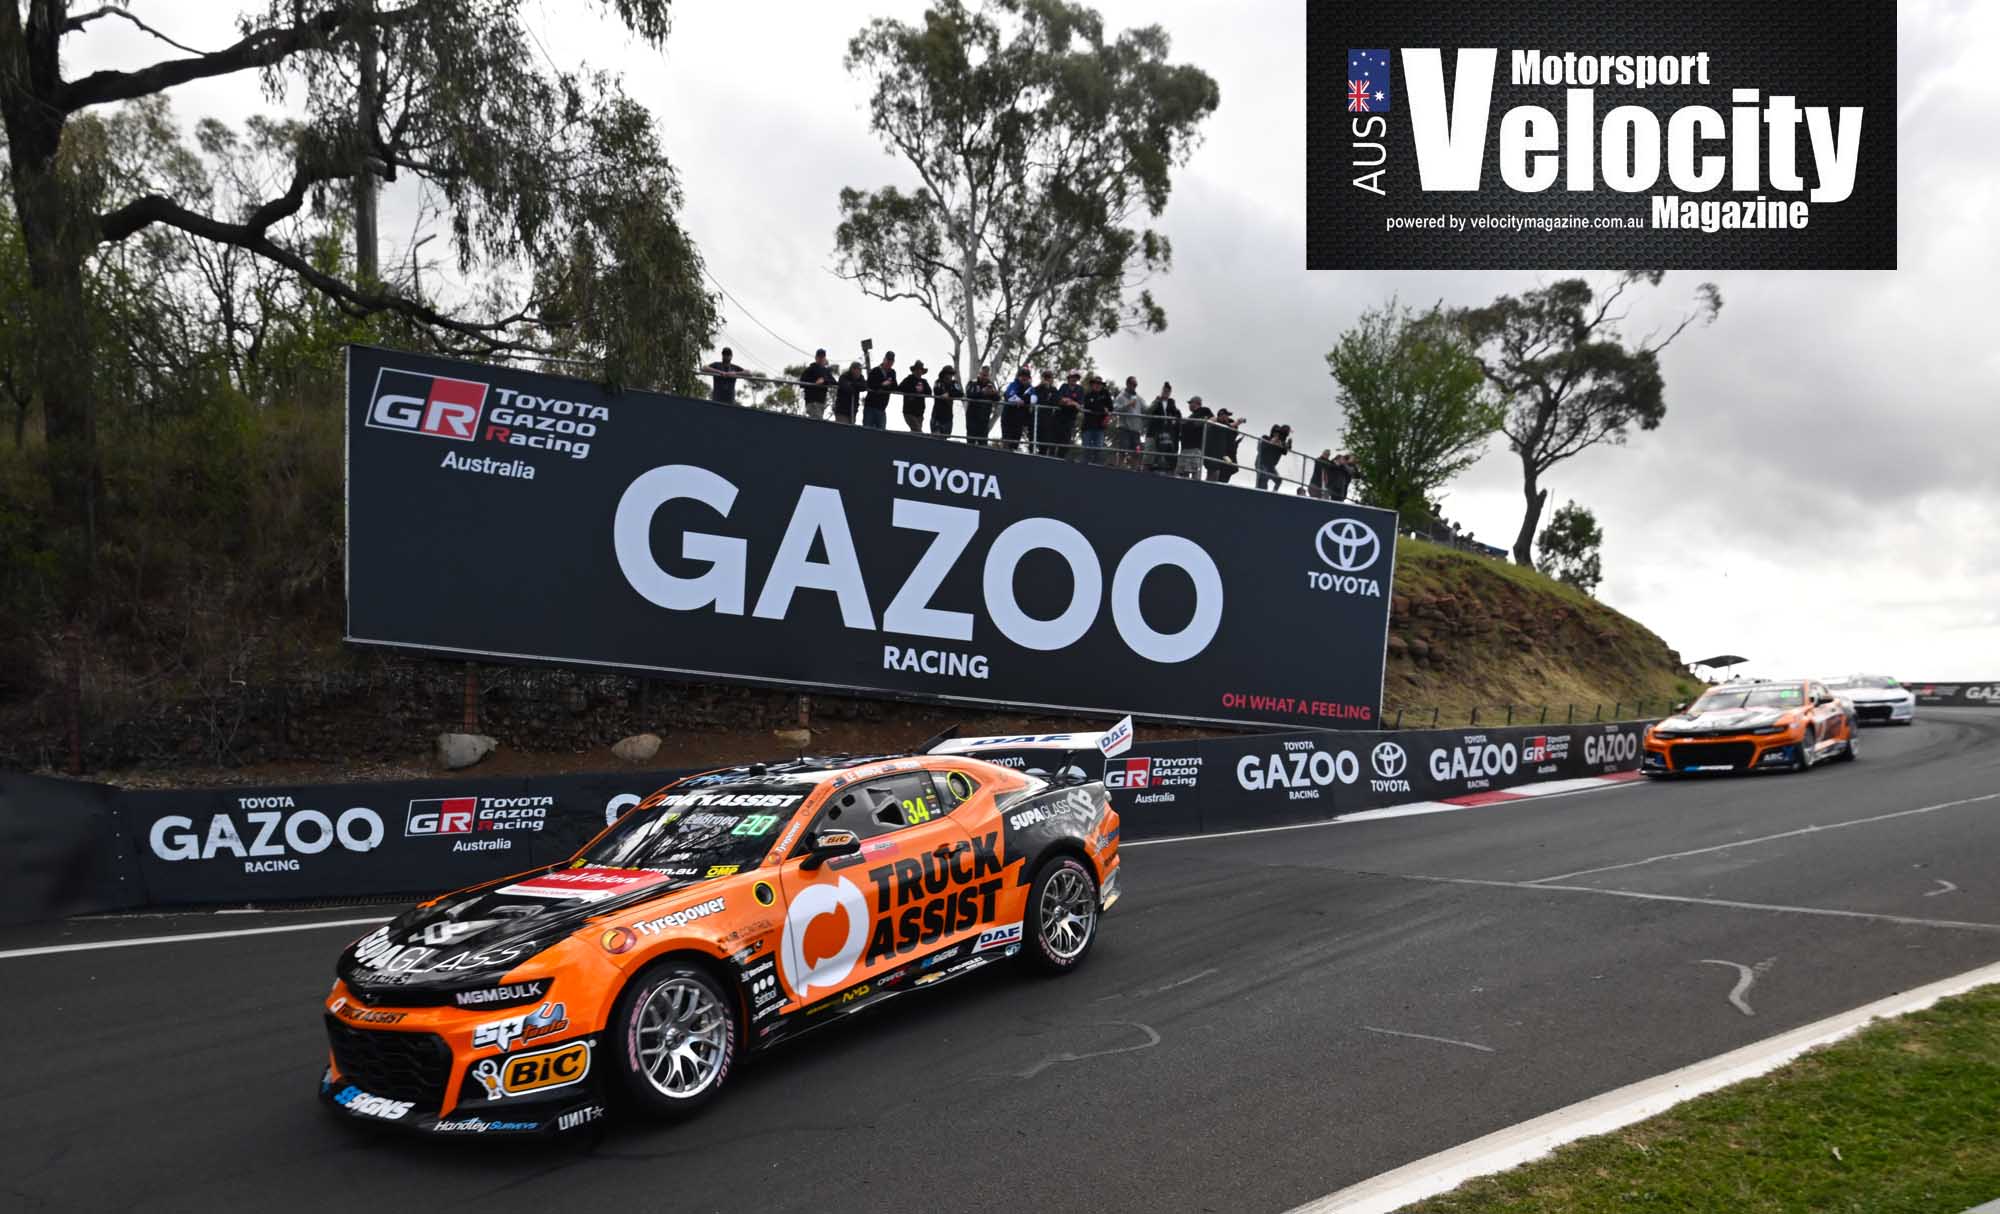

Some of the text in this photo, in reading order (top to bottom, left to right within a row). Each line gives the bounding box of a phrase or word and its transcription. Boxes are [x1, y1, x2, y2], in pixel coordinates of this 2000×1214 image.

[494, 386, 611, 422] TOYOTA
[488, 407, 597, 438] GAZOO
[485, 424, 590, 460] Racing
[440, 450, 536, 481] Australia
[892, 459, 1003, 501] TOYOTA
[613, 463, 1225, 664] GAZOO
[1306, 570, 1381, 598] TOYOTA
[882, 645, 990, 680] RACING
[1221, 692, 1372, 721] OH WHAT A FEELING
[969, 733, 1073, 747] DAF
[1100, 724, 1129, 749] DAF
[1282, 740, 1316, 752] TOYOTA
[1583, 731, 1638, 766] GAZOO
[1151, 767, 1199, 777] GAZOO
[1152, 756, 1204, 767] TOYOTA
[1236, 749, 1360, 792] GAZOO
[1429, 741, 1518, 782] GAZOO
[1150, 775, 1198, 788] Racing
[1287, 788, 1321, 801] RACING
[1370, 779, 1411, 793] TOYOTA
[237, 795, 296, 809] TOYOTA
[479, 796, 554, 809] TOYOTA
[902, 797, 930, 825] 34
[1133, 791, 1176, 805] Australia
[476, 818, 545, 832] Racing
[478, 808, 547, 820] GAZOO
[149, 806, 386, 862] GAZOO
[451, 837, 512, 853] Australia
[243, 858, 301, 874] RACING
[868, 831, 1001, 914] TRUCK
[632, 896, 726, 937] Tyrepower
[865, 878, 1003, 968] ASSIST
[980, 926, 1021, 944] DAF
[558, 1107, 593, 1130] UNIT
